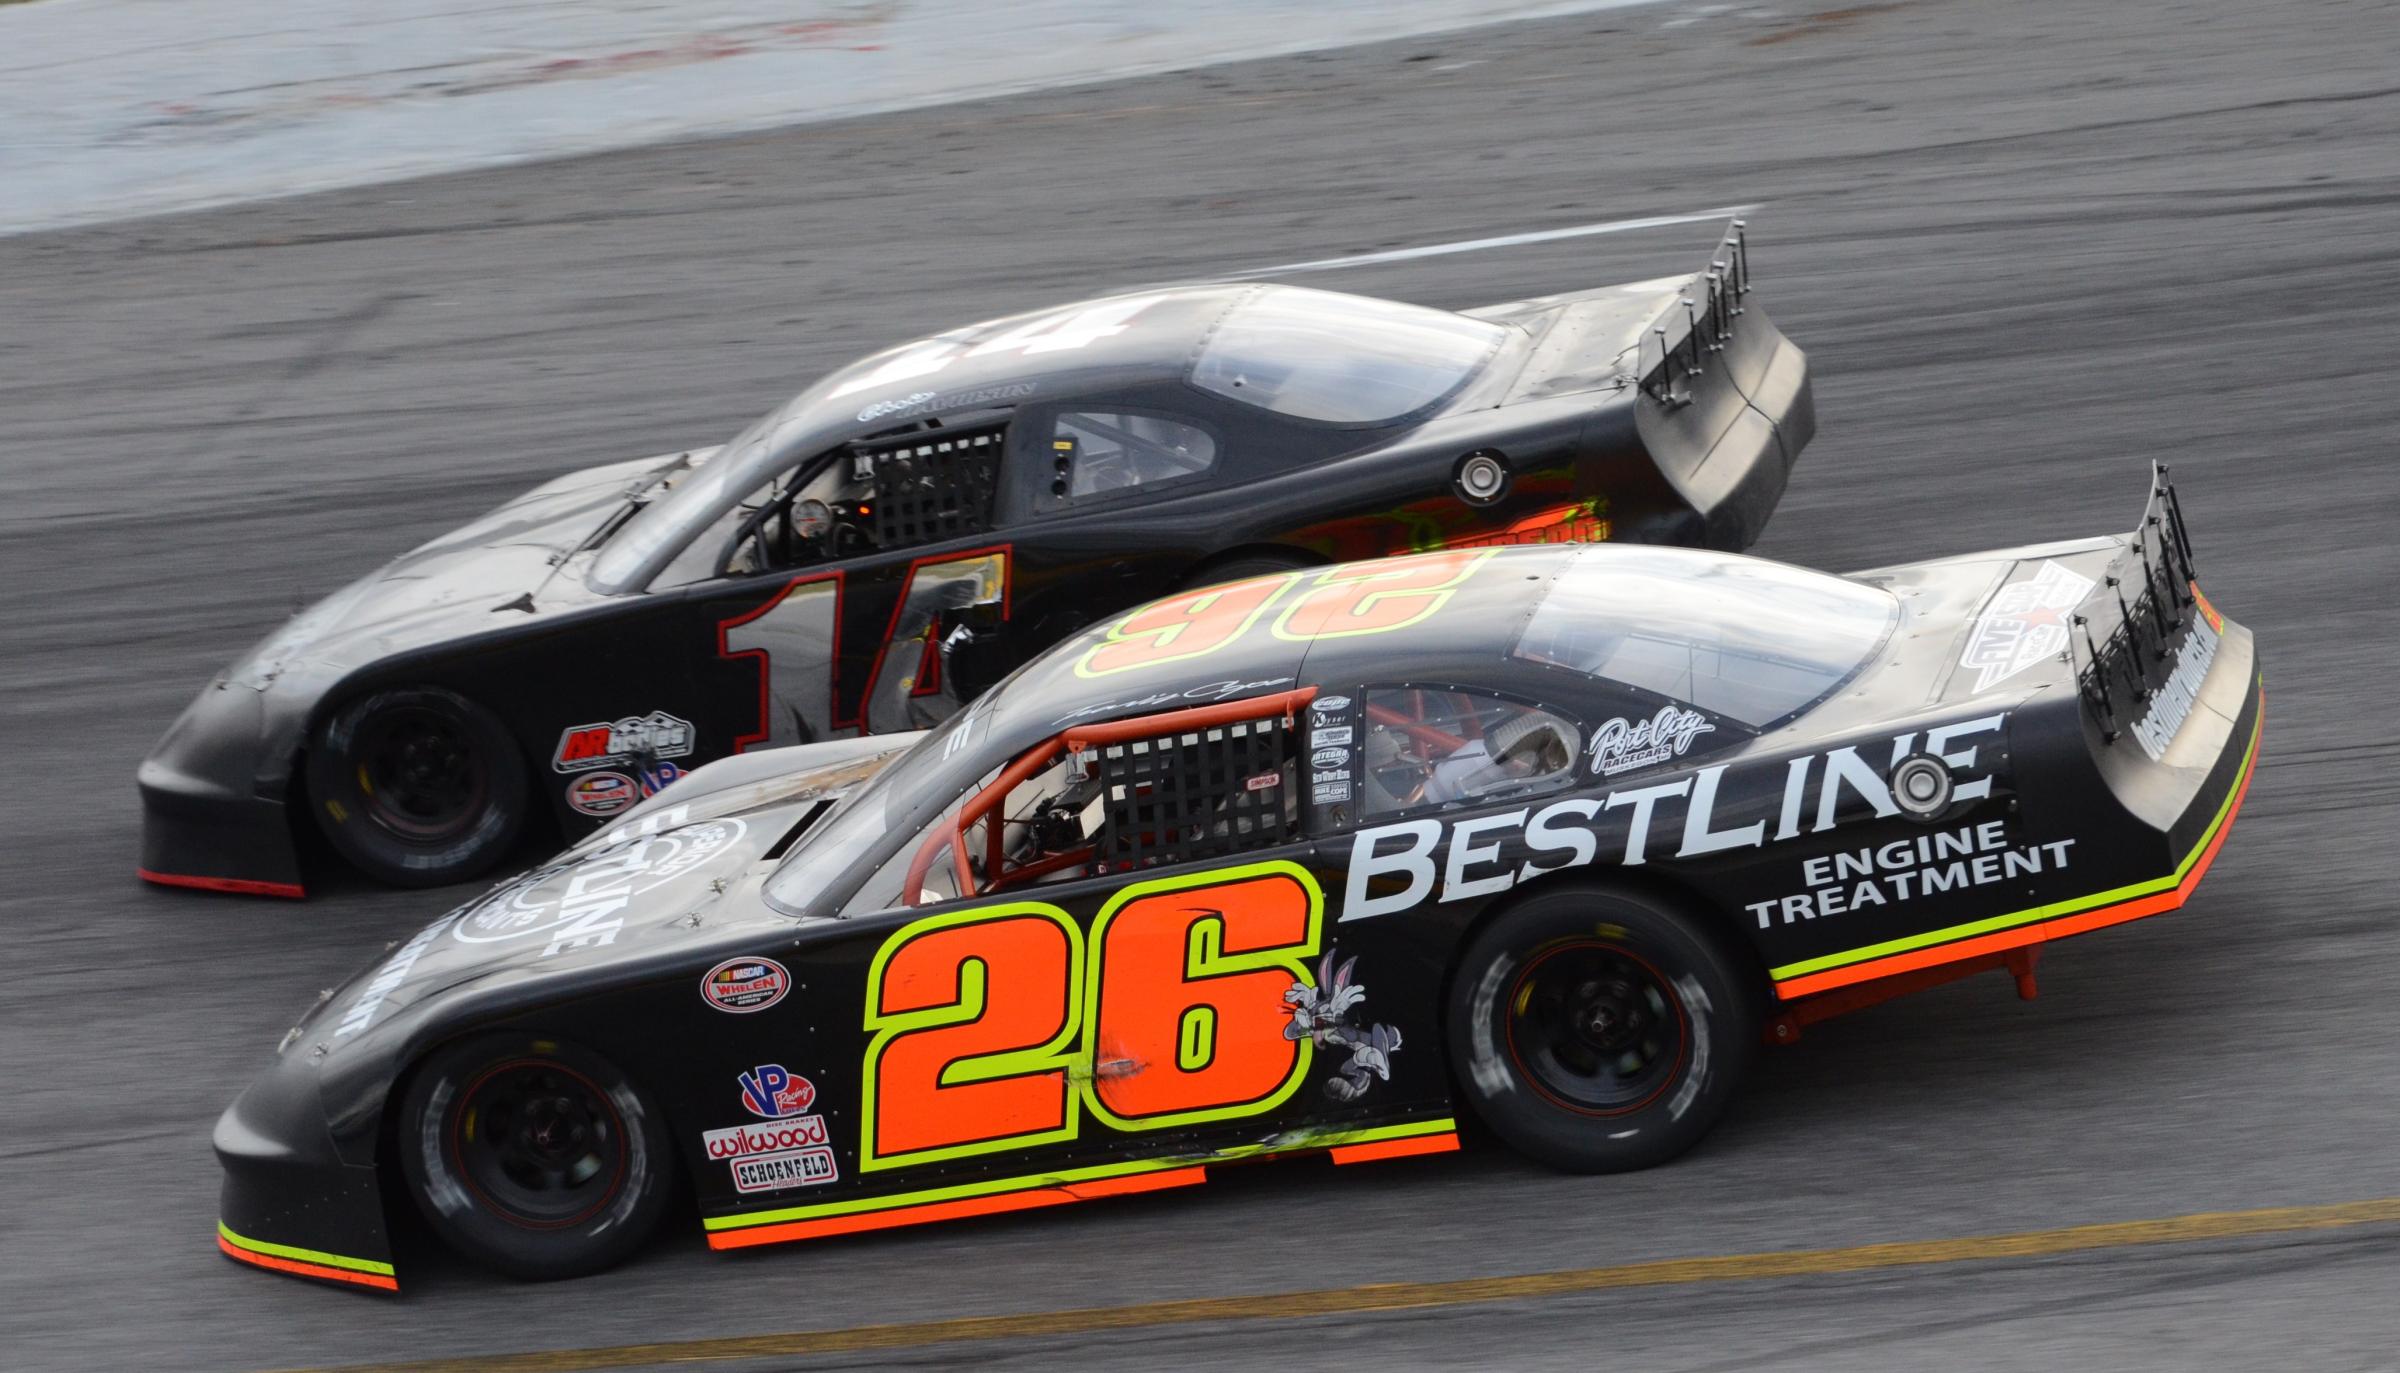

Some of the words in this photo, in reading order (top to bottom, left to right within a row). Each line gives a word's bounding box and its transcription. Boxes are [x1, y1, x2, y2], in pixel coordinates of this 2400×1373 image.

[1968, 618, 2022, 663] FIVE
[561, 728, 610, 761] AR
[1590, 717, 1651, 774] Port
[1650, 706, 1716, 756] City
[1604, 745, 1671, 769] RACECARS
[1339, 713, 2004, 923] BESTLINE
[1801, 821, 2007, 887] ENGINE
[1745, 839, 2076, 929] TREATMENT
[717, 977, 775, 997] WHELEN
[733, 966, 765, 980] NASCAR
[860, 860, 1325, 1172] 26
[738, 1064, 789, 1116] VP
[778, 1086, 812, 1108] Racing
[709, 1116, 826, 1158] wilwood
[739, 1156, 829, 1185] SCHOENFELD
